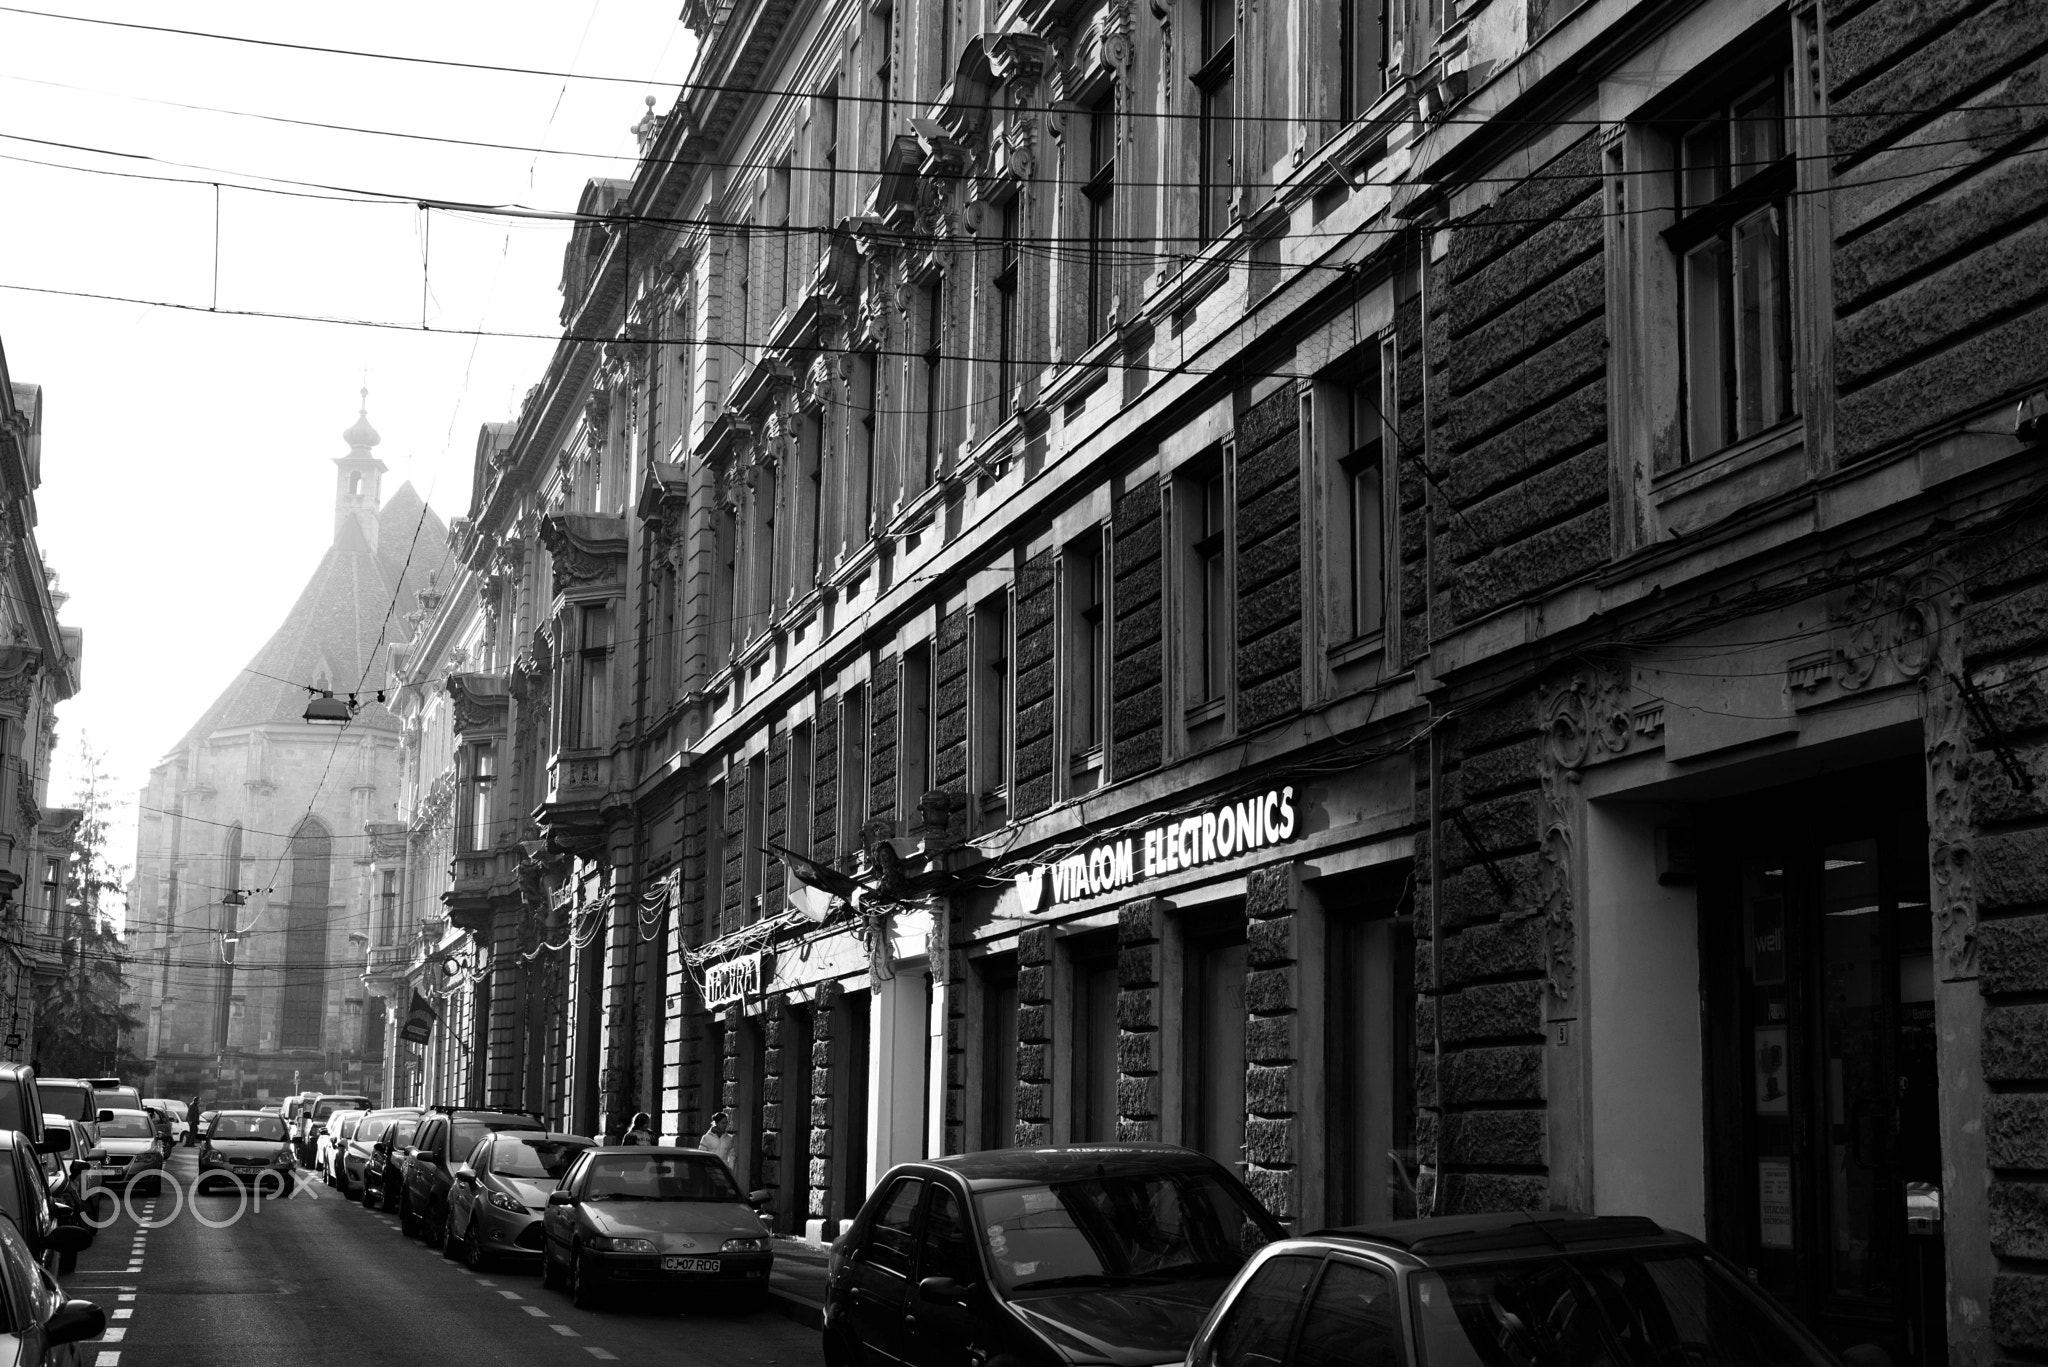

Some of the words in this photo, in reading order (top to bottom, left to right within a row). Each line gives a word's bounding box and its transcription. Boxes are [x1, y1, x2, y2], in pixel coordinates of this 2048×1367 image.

[1052, 838, 1133, 903] VITACOM
[1145, 786, 1295, 876] ELECTRONICS
[1755, 927, 1781, 953] well
